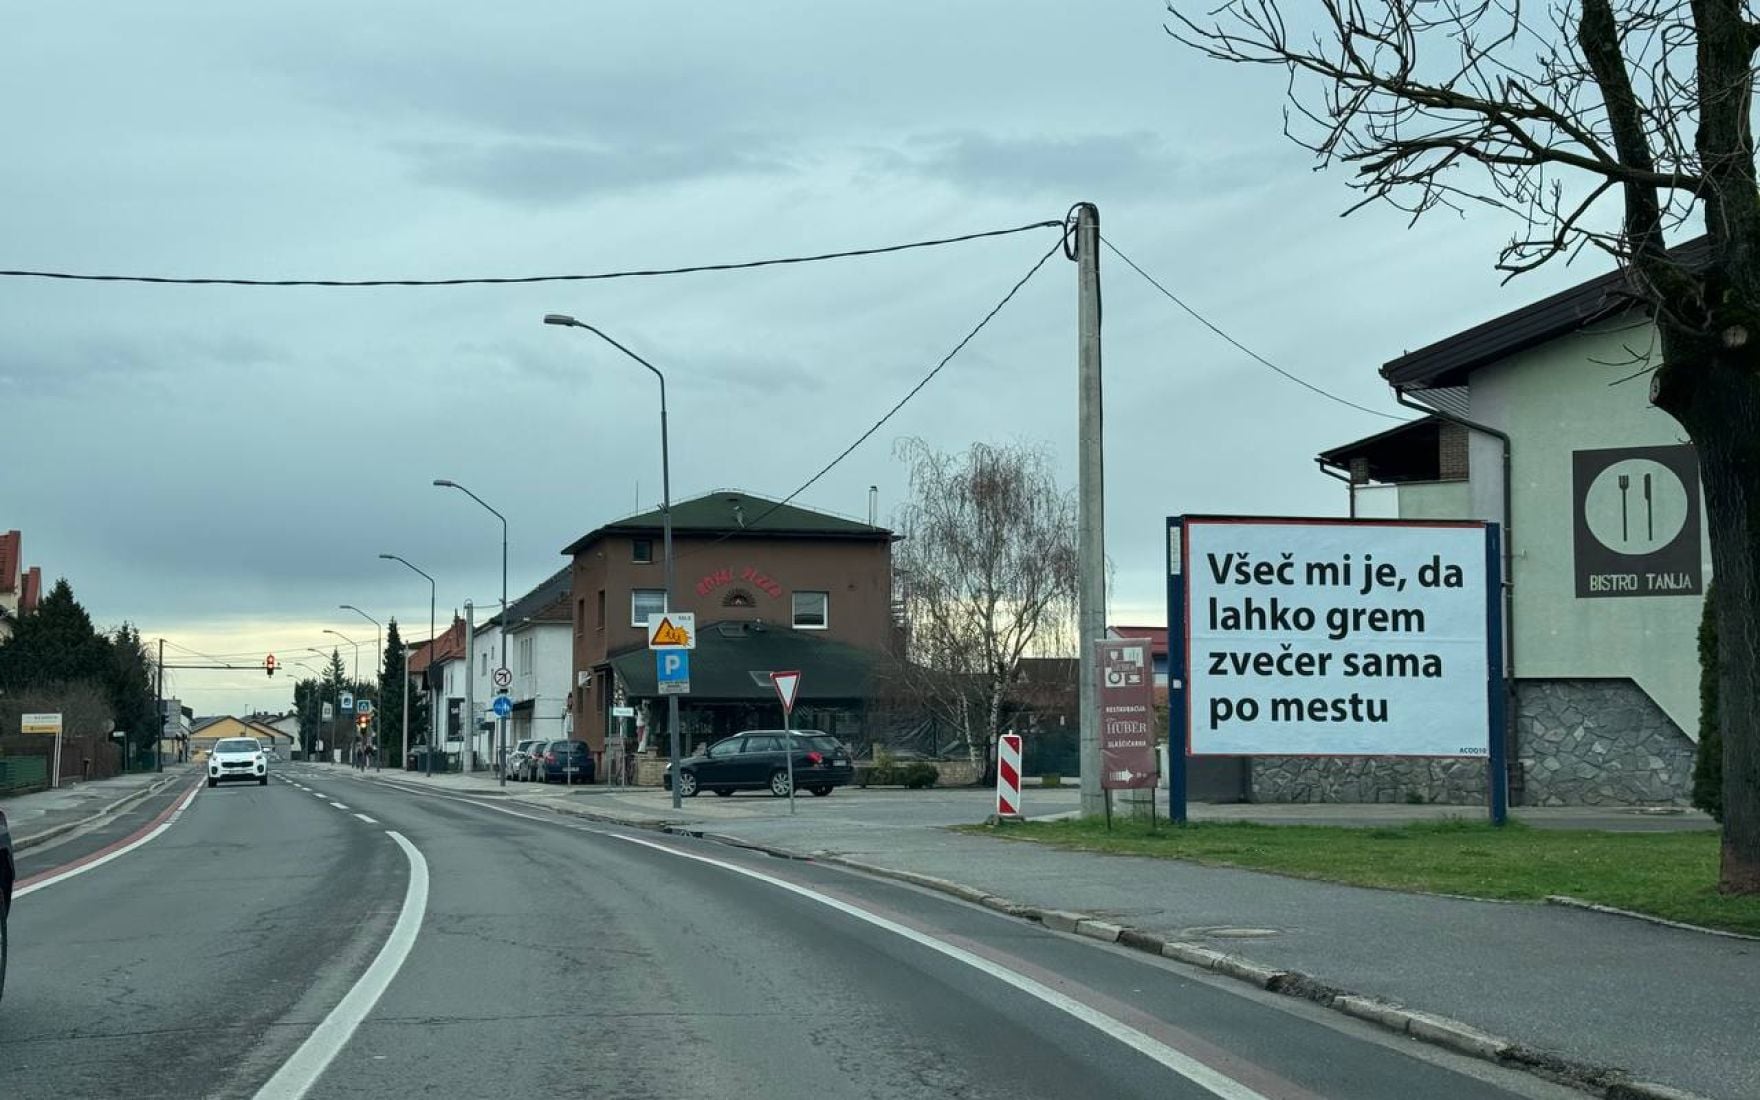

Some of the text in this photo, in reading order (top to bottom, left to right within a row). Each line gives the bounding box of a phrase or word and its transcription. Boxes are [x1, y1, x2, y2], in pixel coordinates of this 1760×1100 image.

[1206, 551, 1295, 586] Všeč
[1305, 553, 1351, 587] mi
[1359, 553, 1407, 596] je,
[1418, 554, 1464, 588] da
[1590, 572, 1692, 592] BISTRO TANJA
[1209, 596, 1425, 641] lahko grem
[665, 655, 680, 676] P
[1208, 643, 1442, 678] zvečer sama
[1107, 721, 1147, 734] HUBER
[1209, 692, 1388, 730] po mestu
